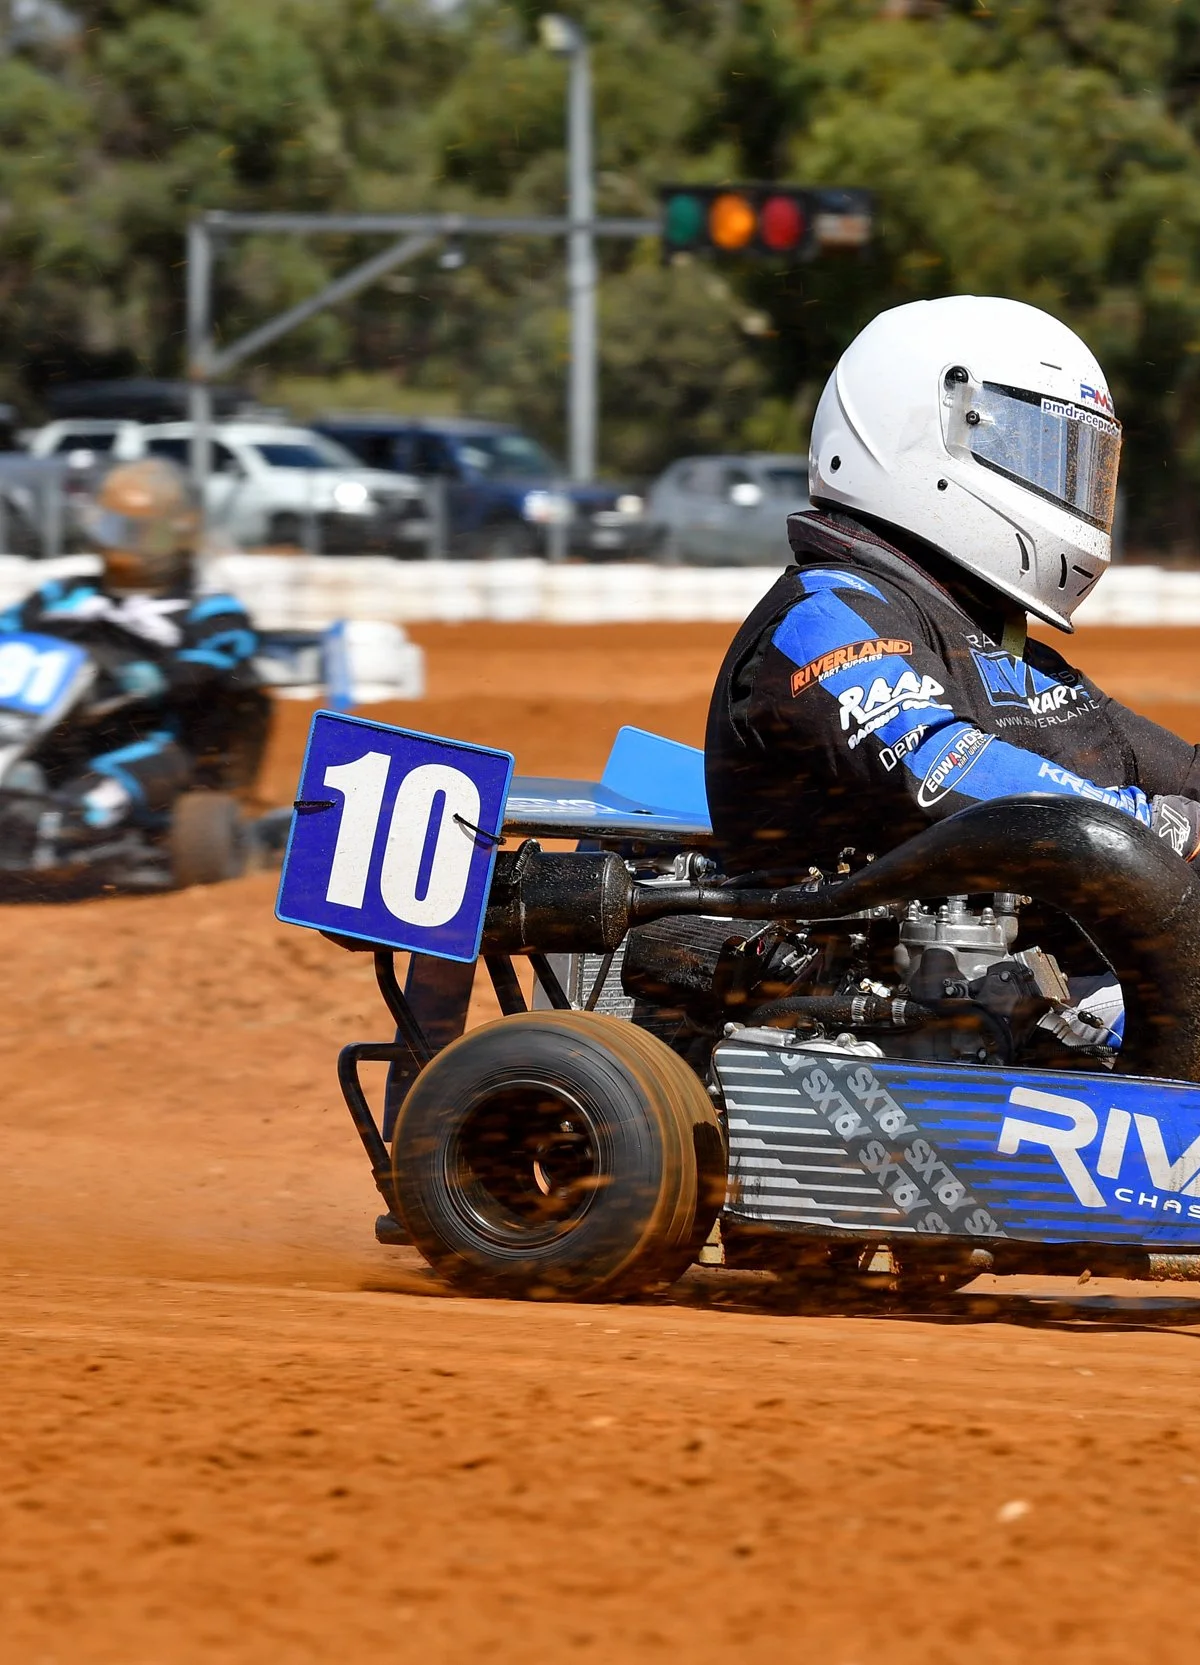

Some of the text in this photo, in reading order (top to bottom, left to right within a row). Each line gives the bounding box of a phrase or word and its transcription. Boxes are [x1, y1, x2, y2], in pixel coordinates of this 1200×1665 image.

[793, 640, 911, 692] RIVERLAND
[818, 666, 841, 682] KART
[926, 728, 985, 793] EDWARDS
[323, 751, 481, 927] 10
